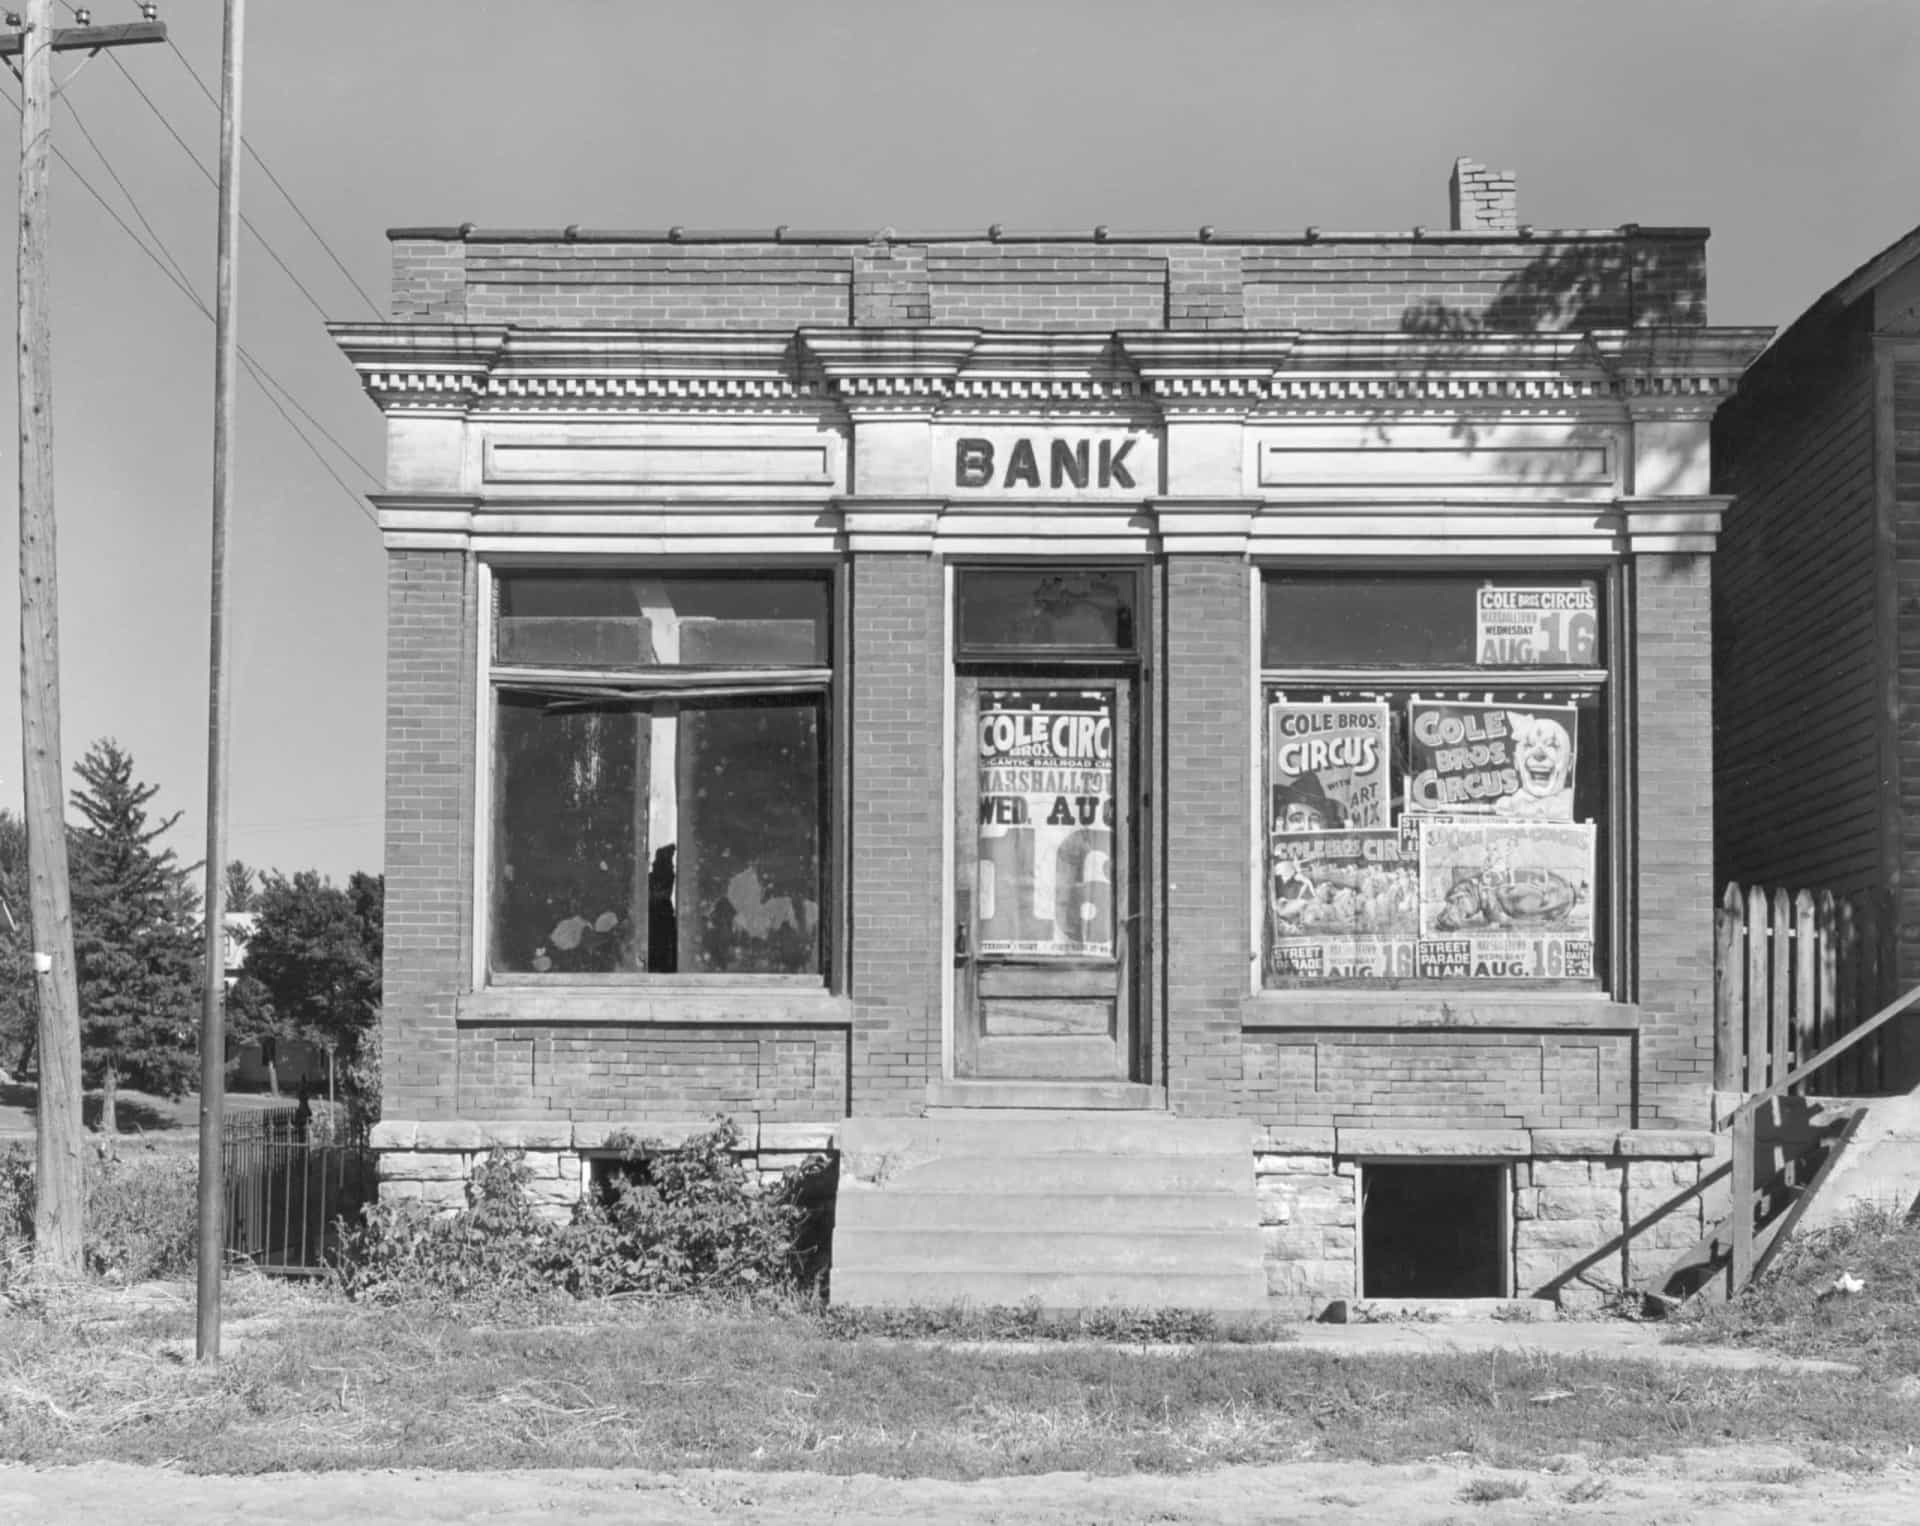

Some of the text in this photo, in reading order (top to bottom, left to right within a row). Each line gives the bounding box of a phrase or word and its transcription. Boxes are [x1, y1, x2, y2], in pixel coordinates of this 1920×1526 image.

[956, 438, 1136, 488] BANK
[1483, 593, 1517, 608] COLE
[1541, 593, 1594, 608] CIRCUS
[1538, 612, 1595, 664] 16
[980, 715, 1050, 757] COLE
[1051, 716, 1112, 759] CIRC
[1280, 713, 1381, 737] COLE BROS.
[1414, 711, 1507, 747] COLE
[1279, 737, 1380, 777] CIRCUS
[1350, 782, 1379, 808] ART
[1413, 768, 1519, 812] CIRCUS
[1274, 946, 1321, 960] STREET
[1420, 942, 1468, 953] STREET
[1421, 953, 1470, 964] PARADE
[1533, 940, 1563, 977] 16
[1475, 962, 1529, 977] AUG.
